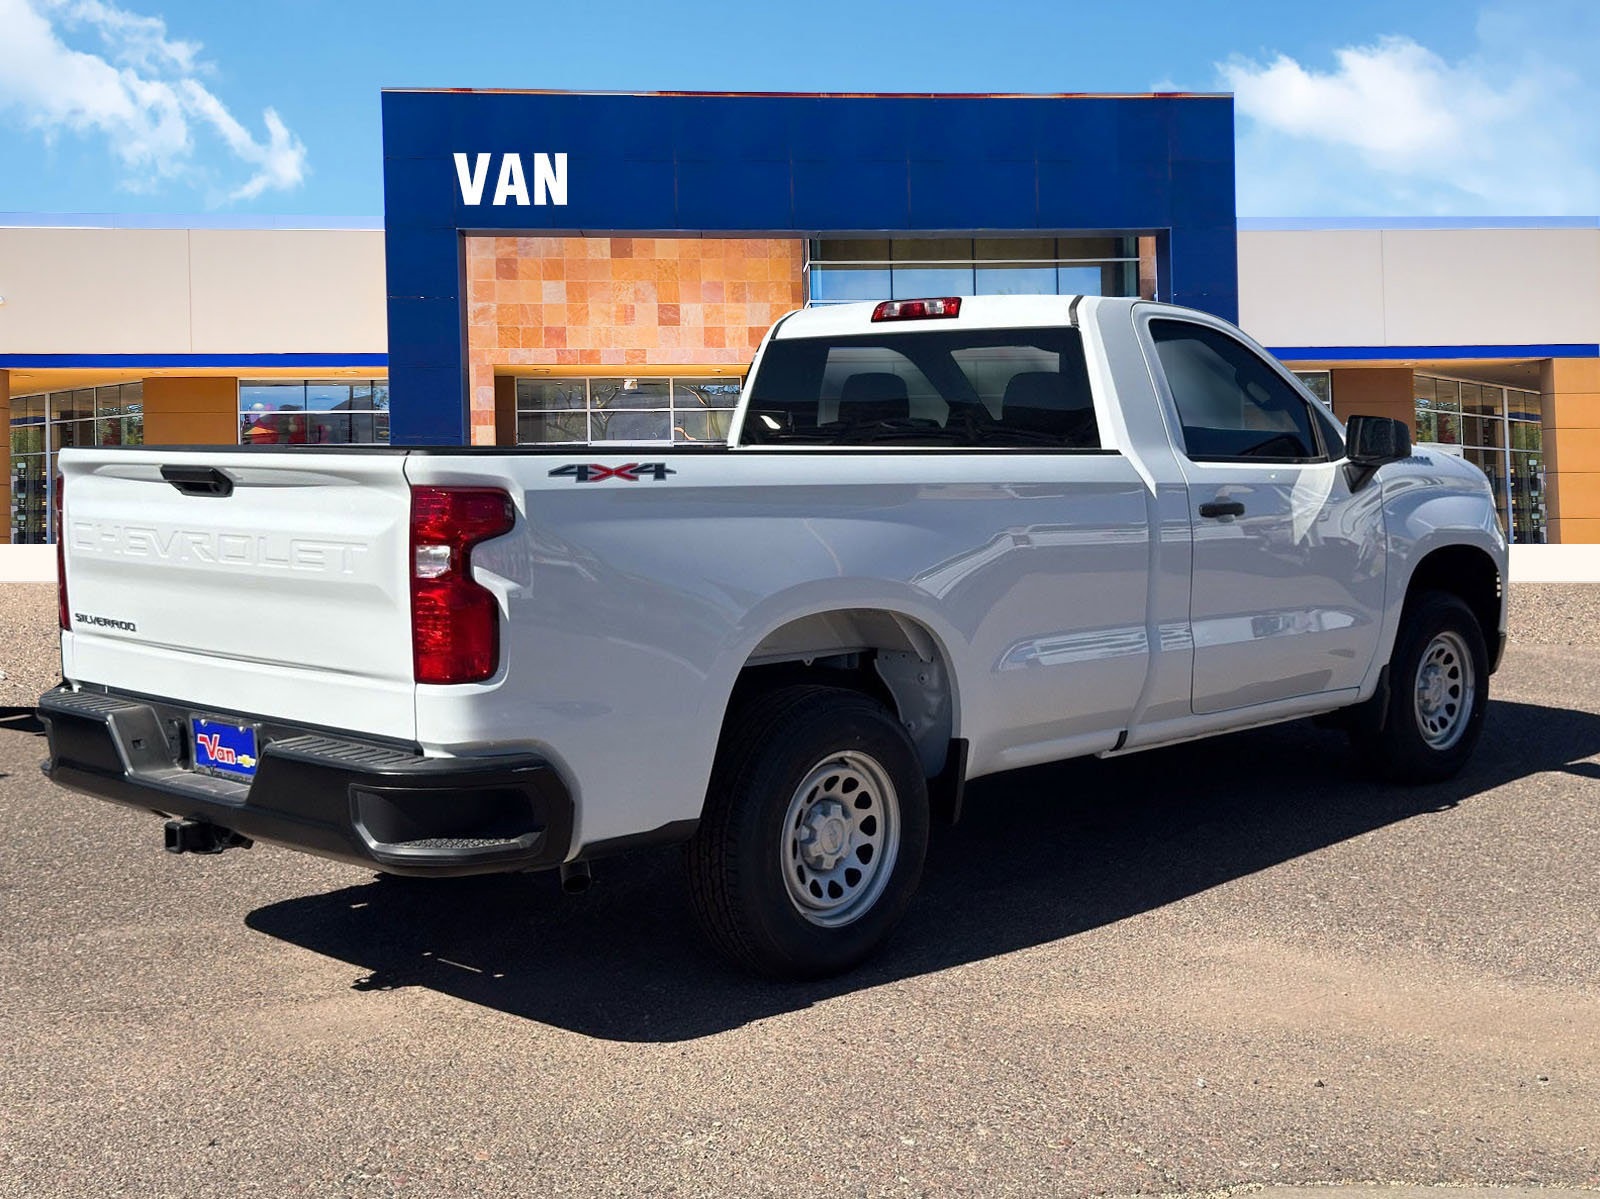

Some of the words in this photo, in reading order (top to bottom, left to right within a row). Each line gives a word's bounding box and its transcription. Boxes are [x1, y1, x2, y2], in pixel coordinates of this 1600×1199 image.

[453, 153, 568, 206] VAN
[73, 521, 369, 574] CHEVROLET
[75, 612, 137, 632] SILVERADO
[197, 733, 237, 765] Van
